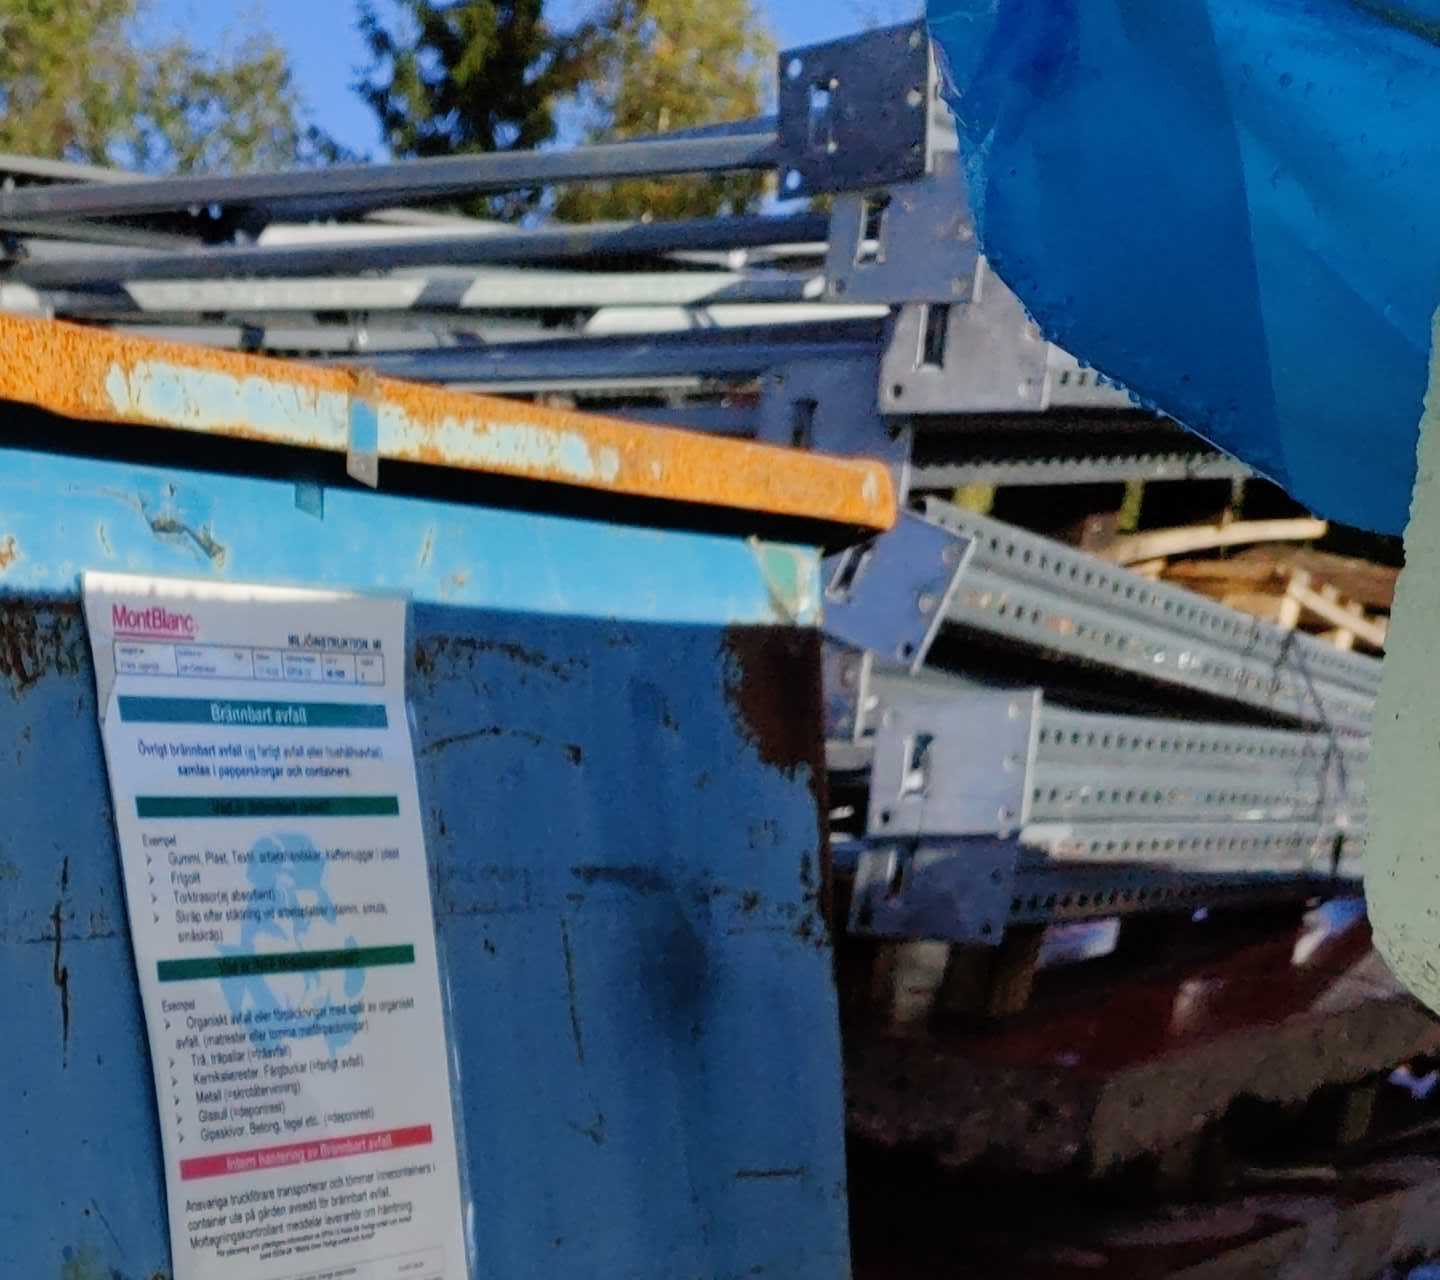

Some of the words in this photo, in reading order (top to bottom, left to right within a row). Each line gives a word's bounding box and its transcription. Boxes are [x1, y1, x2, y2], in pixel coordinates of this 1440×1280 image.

[211, 702, 271, 723] Brännbart
[275, 706, 308, 724] avfall
[138, 739, 168, 759] Övrigt
[169, 743, 215, 758] brännbart
[218, 743, 242, 758] avfall
[177, 765, 210, 777] samlas
[219, 766, 283, 781] papperskorgar
[287, 765, 303, 777] och
[161, 999, 195, 1013] Exempel
[186, 1014, 228, 1032] Organiskt
[195, 1089, 222, 1104] Metall
[198, 1107, 227, 1123] Glasull
[226, 1155, 256, 1170] Intern
[257, 1148, 305, 1167] hantering
[307, 1147, 319, 1159] av
[368, 1134, 393, 1151] avfall
[186, 1197, 228, 1212] Ansvariga
[230, 1189, 275, 1206] truckförare
[277, 1181, 327, 1199] transporterar
[329, 1177, 344, 1188] och
[187, 1216, 227, 1232] container
[230, 1212, 242, 1225] ute
[245, 1208, 257, 1224] på
[258, 1205, 286, 1221] gården
[319, 1196, 328, 1209] för
[331, 1190, 367, 1207] brännbart
[190, 1223, 284, 1249] Mottagningskontrollant
[363, 1207, 375, 1218] om
[377, 1201, 412, 1219] hämtning
